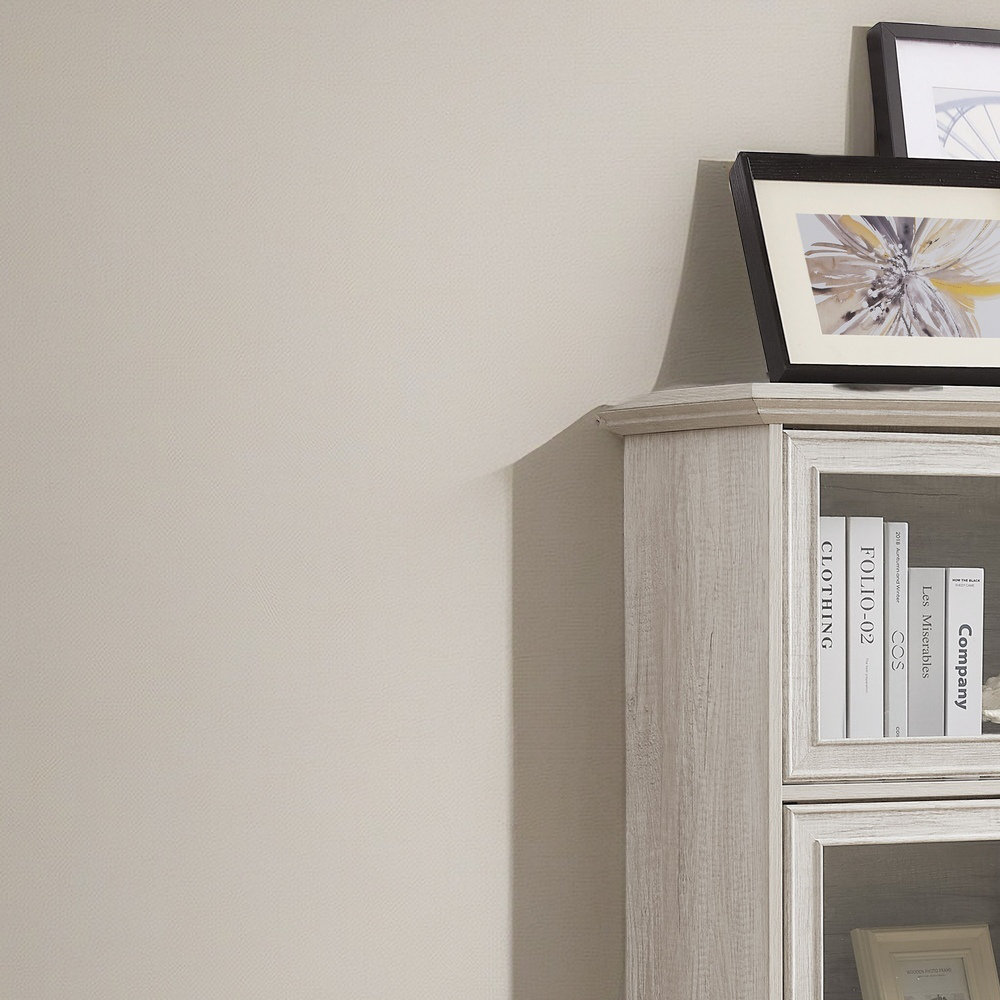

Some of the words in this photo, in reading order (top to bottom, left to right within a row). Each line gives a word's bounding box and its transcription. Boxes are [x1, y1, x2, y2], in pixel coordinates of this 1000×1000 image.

[820, 540, 833, 650] CLOTHING
[859, 546, 876, 645] FOLIO-02
[922, 586, 933, 607] Les
[891, 630, 905, 671] COS
[921, 614, 933, 679] Miserables
[954, 623, 972, 711] Company
